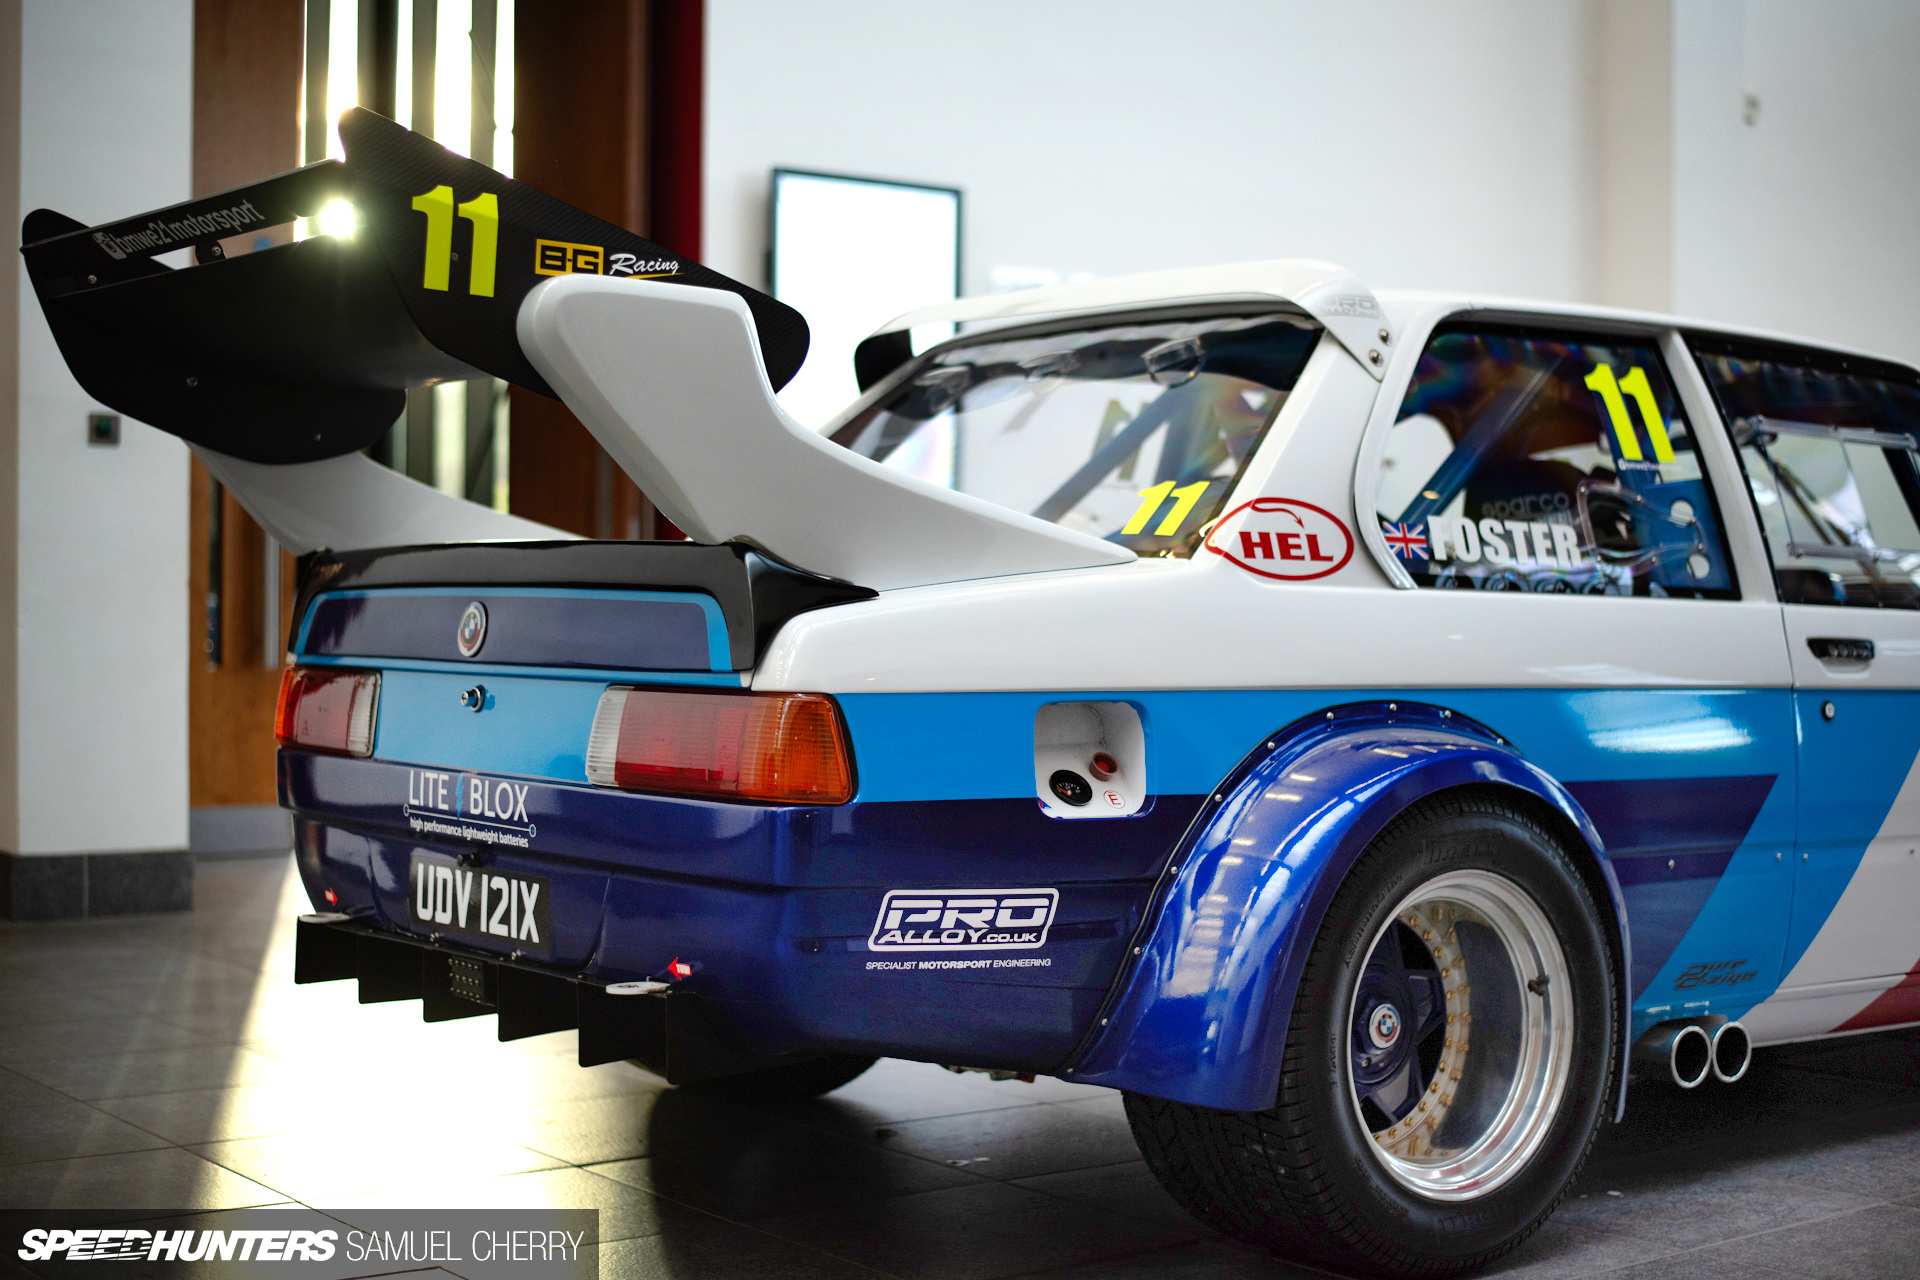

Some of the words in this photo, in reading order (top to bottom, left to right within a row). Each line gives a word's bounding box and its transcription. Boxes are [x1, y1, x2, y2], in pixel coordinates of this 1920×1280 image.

[109, 199, 265, 256] bmwe21motorsport
[412, 185, 499, 298] 11
[609, 253, 680, 275] Racing
[1584, 363, 1675, 463] 11
[1120, 480, 1210, 536] 11
[1238, 531, 1334, 562] HEL
[1427, 515, 1582, 568] FOSTER
[409, 769, 449, 811] LITE
[470, 777, 529, 823] BLOX
[409, 816, 424, 832] high
[424, 820, 462, 836] performance
[462, 825, 499, 845] lightweight
[499, 831, 529, 848] batteries
[416, 863, 474, 928] UDV
[480, 873, 540, 944] 121X
[884, 898, 1050, 929] PRO
[878, 928, 1038, 944] ALLOY.CO.UK
[866, 961, 917, 970] SPECIALIST
[918, 959, 992, 970] MOTORSPORT
[993, 958, 1051, 969] ENGINEERING
